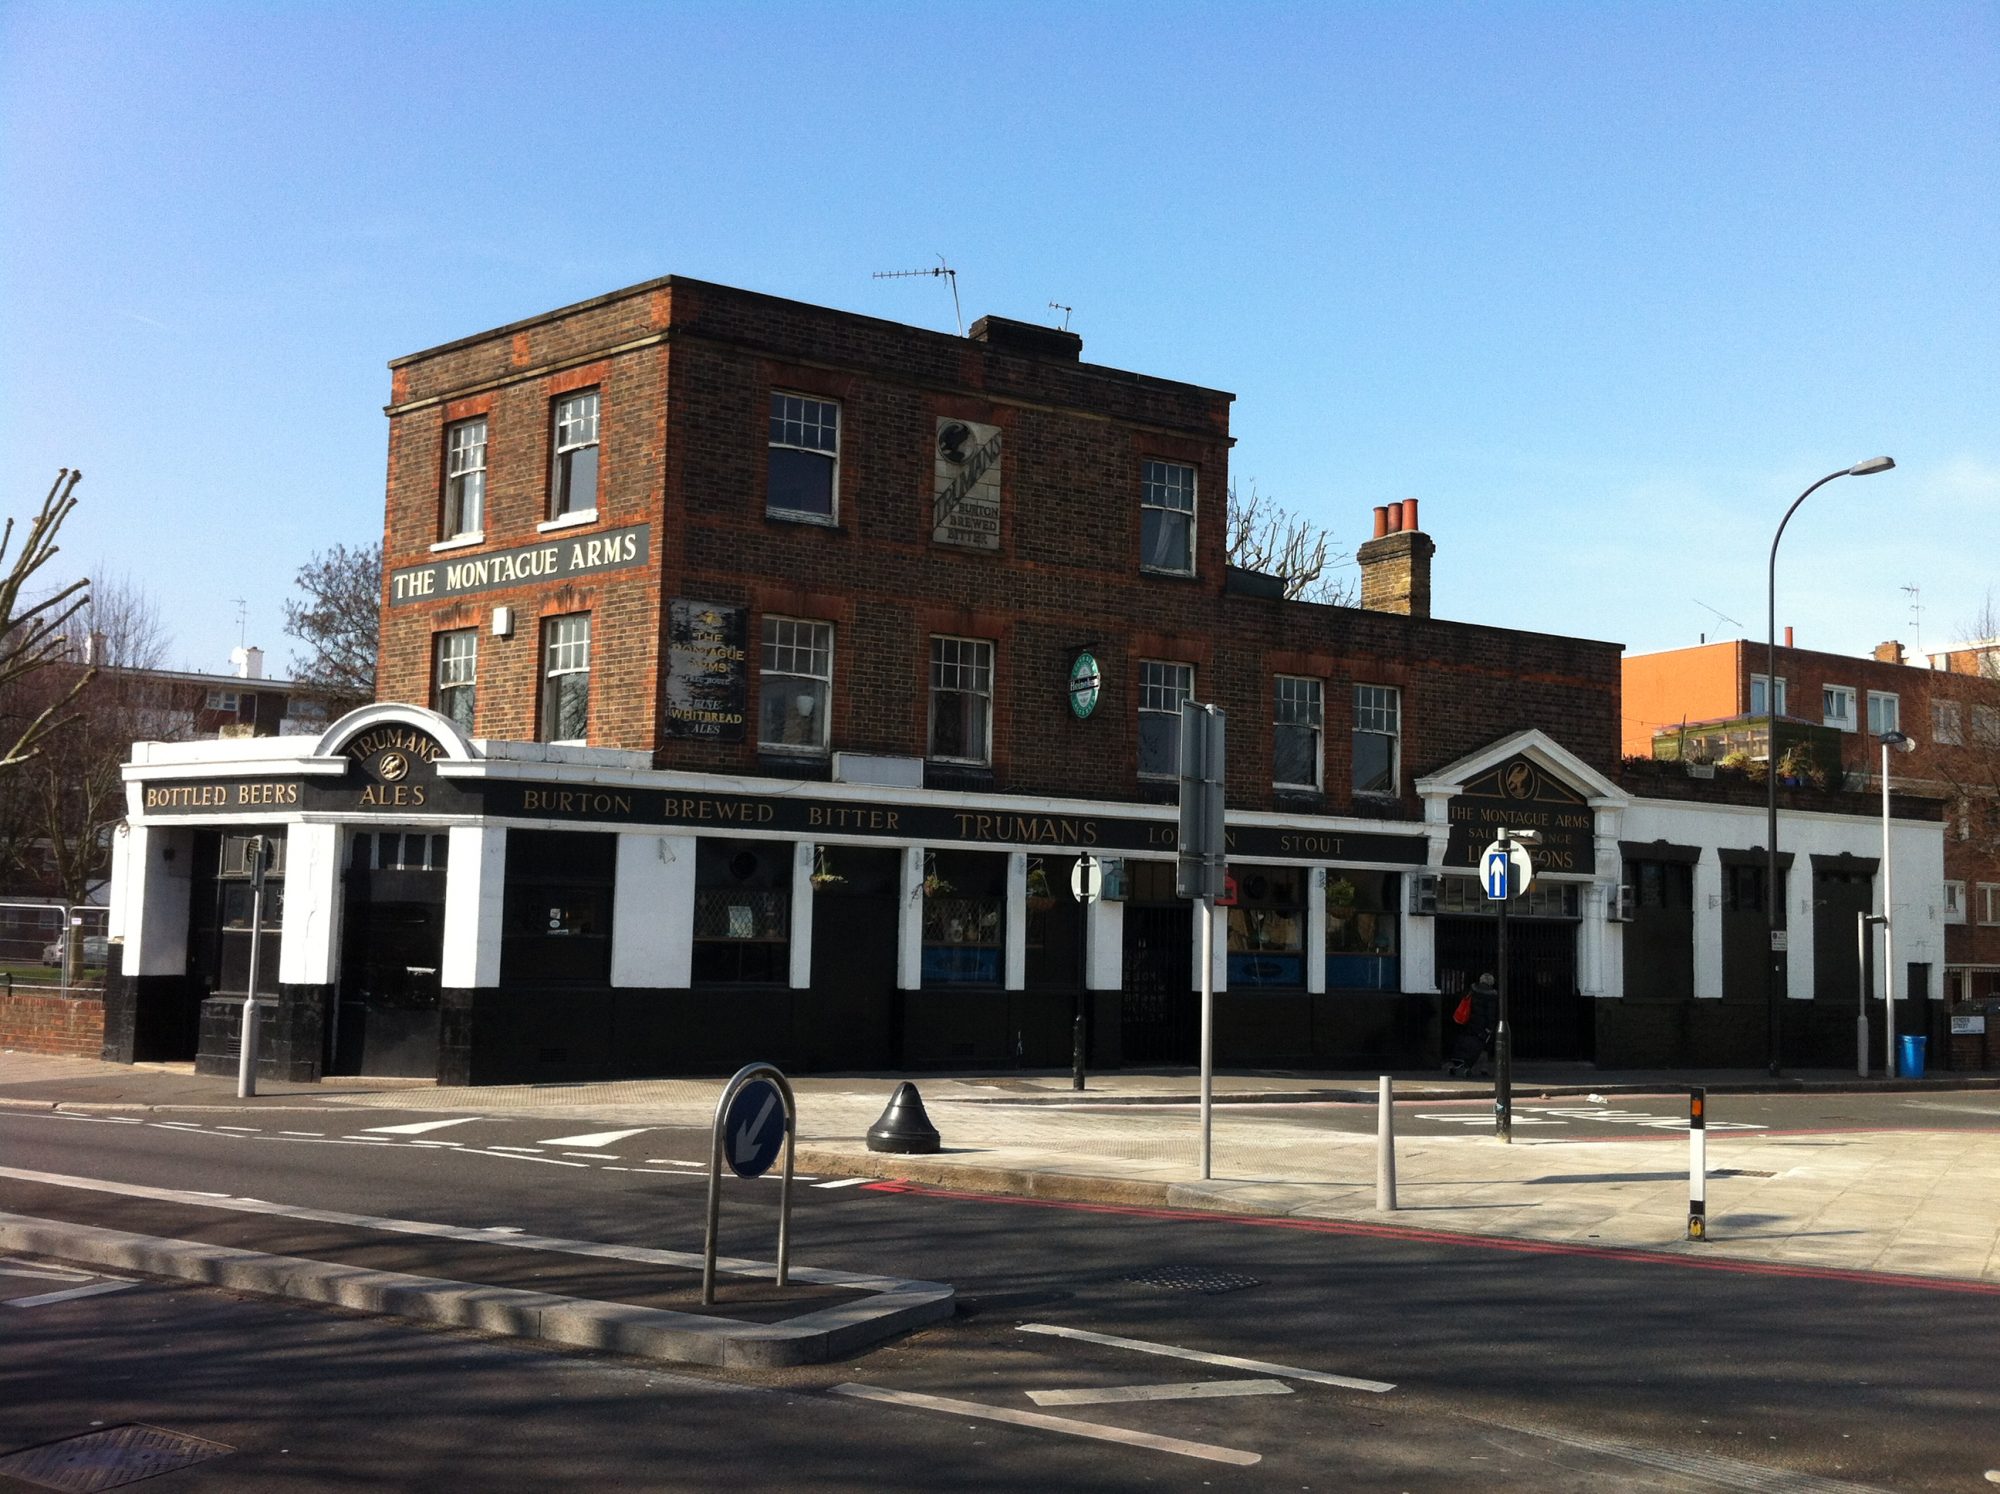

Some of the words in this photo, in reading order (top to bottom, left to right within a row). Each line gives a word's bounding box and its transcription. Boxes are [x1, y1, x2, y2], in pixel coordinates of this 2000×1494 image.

[959, 503, 999, 519] BURTON
[950, 515, 997, 531] BREWED
[948, 528, 988, 544] BITTER
[394, 569, 436, 600] THE
[446, 548, 559, 591] MONTAGUE
[569, 533, 637, 570] ARMS
[694, 631, 724, 643] THE
[688, 660, 727, 673] RMS
[671, 709, 742, 724] WHITBREAD
[692, 725, 720, 734] ALES
[349, 728, 441, 764] TRUMANS
[147, 786, 226, 807] BOTTLED
[238, 784, 297, 804] BEERS
[359, 785, 426, 807] ALES
[523, 790, 632, 814] BURTON
[664, 798, 774, 823] BREWED
[809, 807, 900, 830] BITTER
[1450, 806, 1474, 820] THE
[1480, 808, 1549, 826] MONTAGUE
[1555, 814, 1590, 828] ARMS
[953, 813, 1097, 845] TRUMANS
[1149, 827, 1236, 848] LON
[1281, 835, 1344, 855] STOUT
[1468, 845, 1574, 869] LEONS
